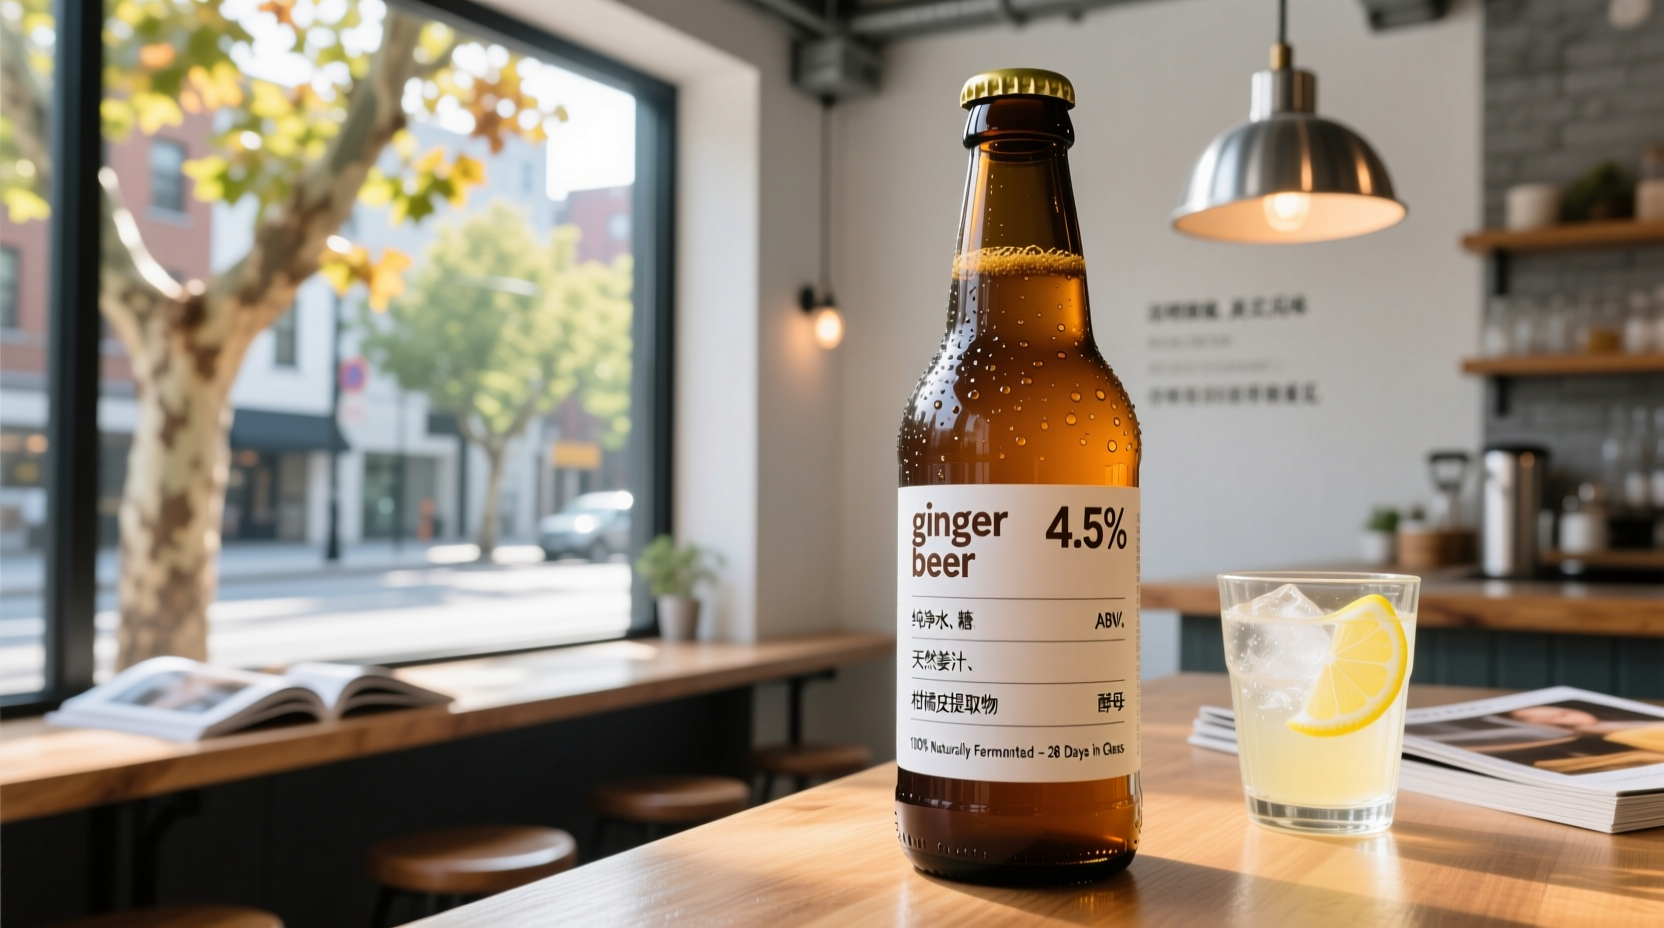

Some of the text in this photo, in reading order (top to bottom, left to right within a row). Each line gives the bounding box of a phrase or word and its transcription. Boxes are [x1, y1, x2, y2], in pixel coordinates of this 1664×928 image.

[912, 501, 1008, 547] ginger
[1045, 506, 1127, 549] 4.5%
[912, 547, 975, 578] beer
[912, 650, 972, 672] 天然姜汁、
[911, 690, 998, 715] 柑橘皮提取物
